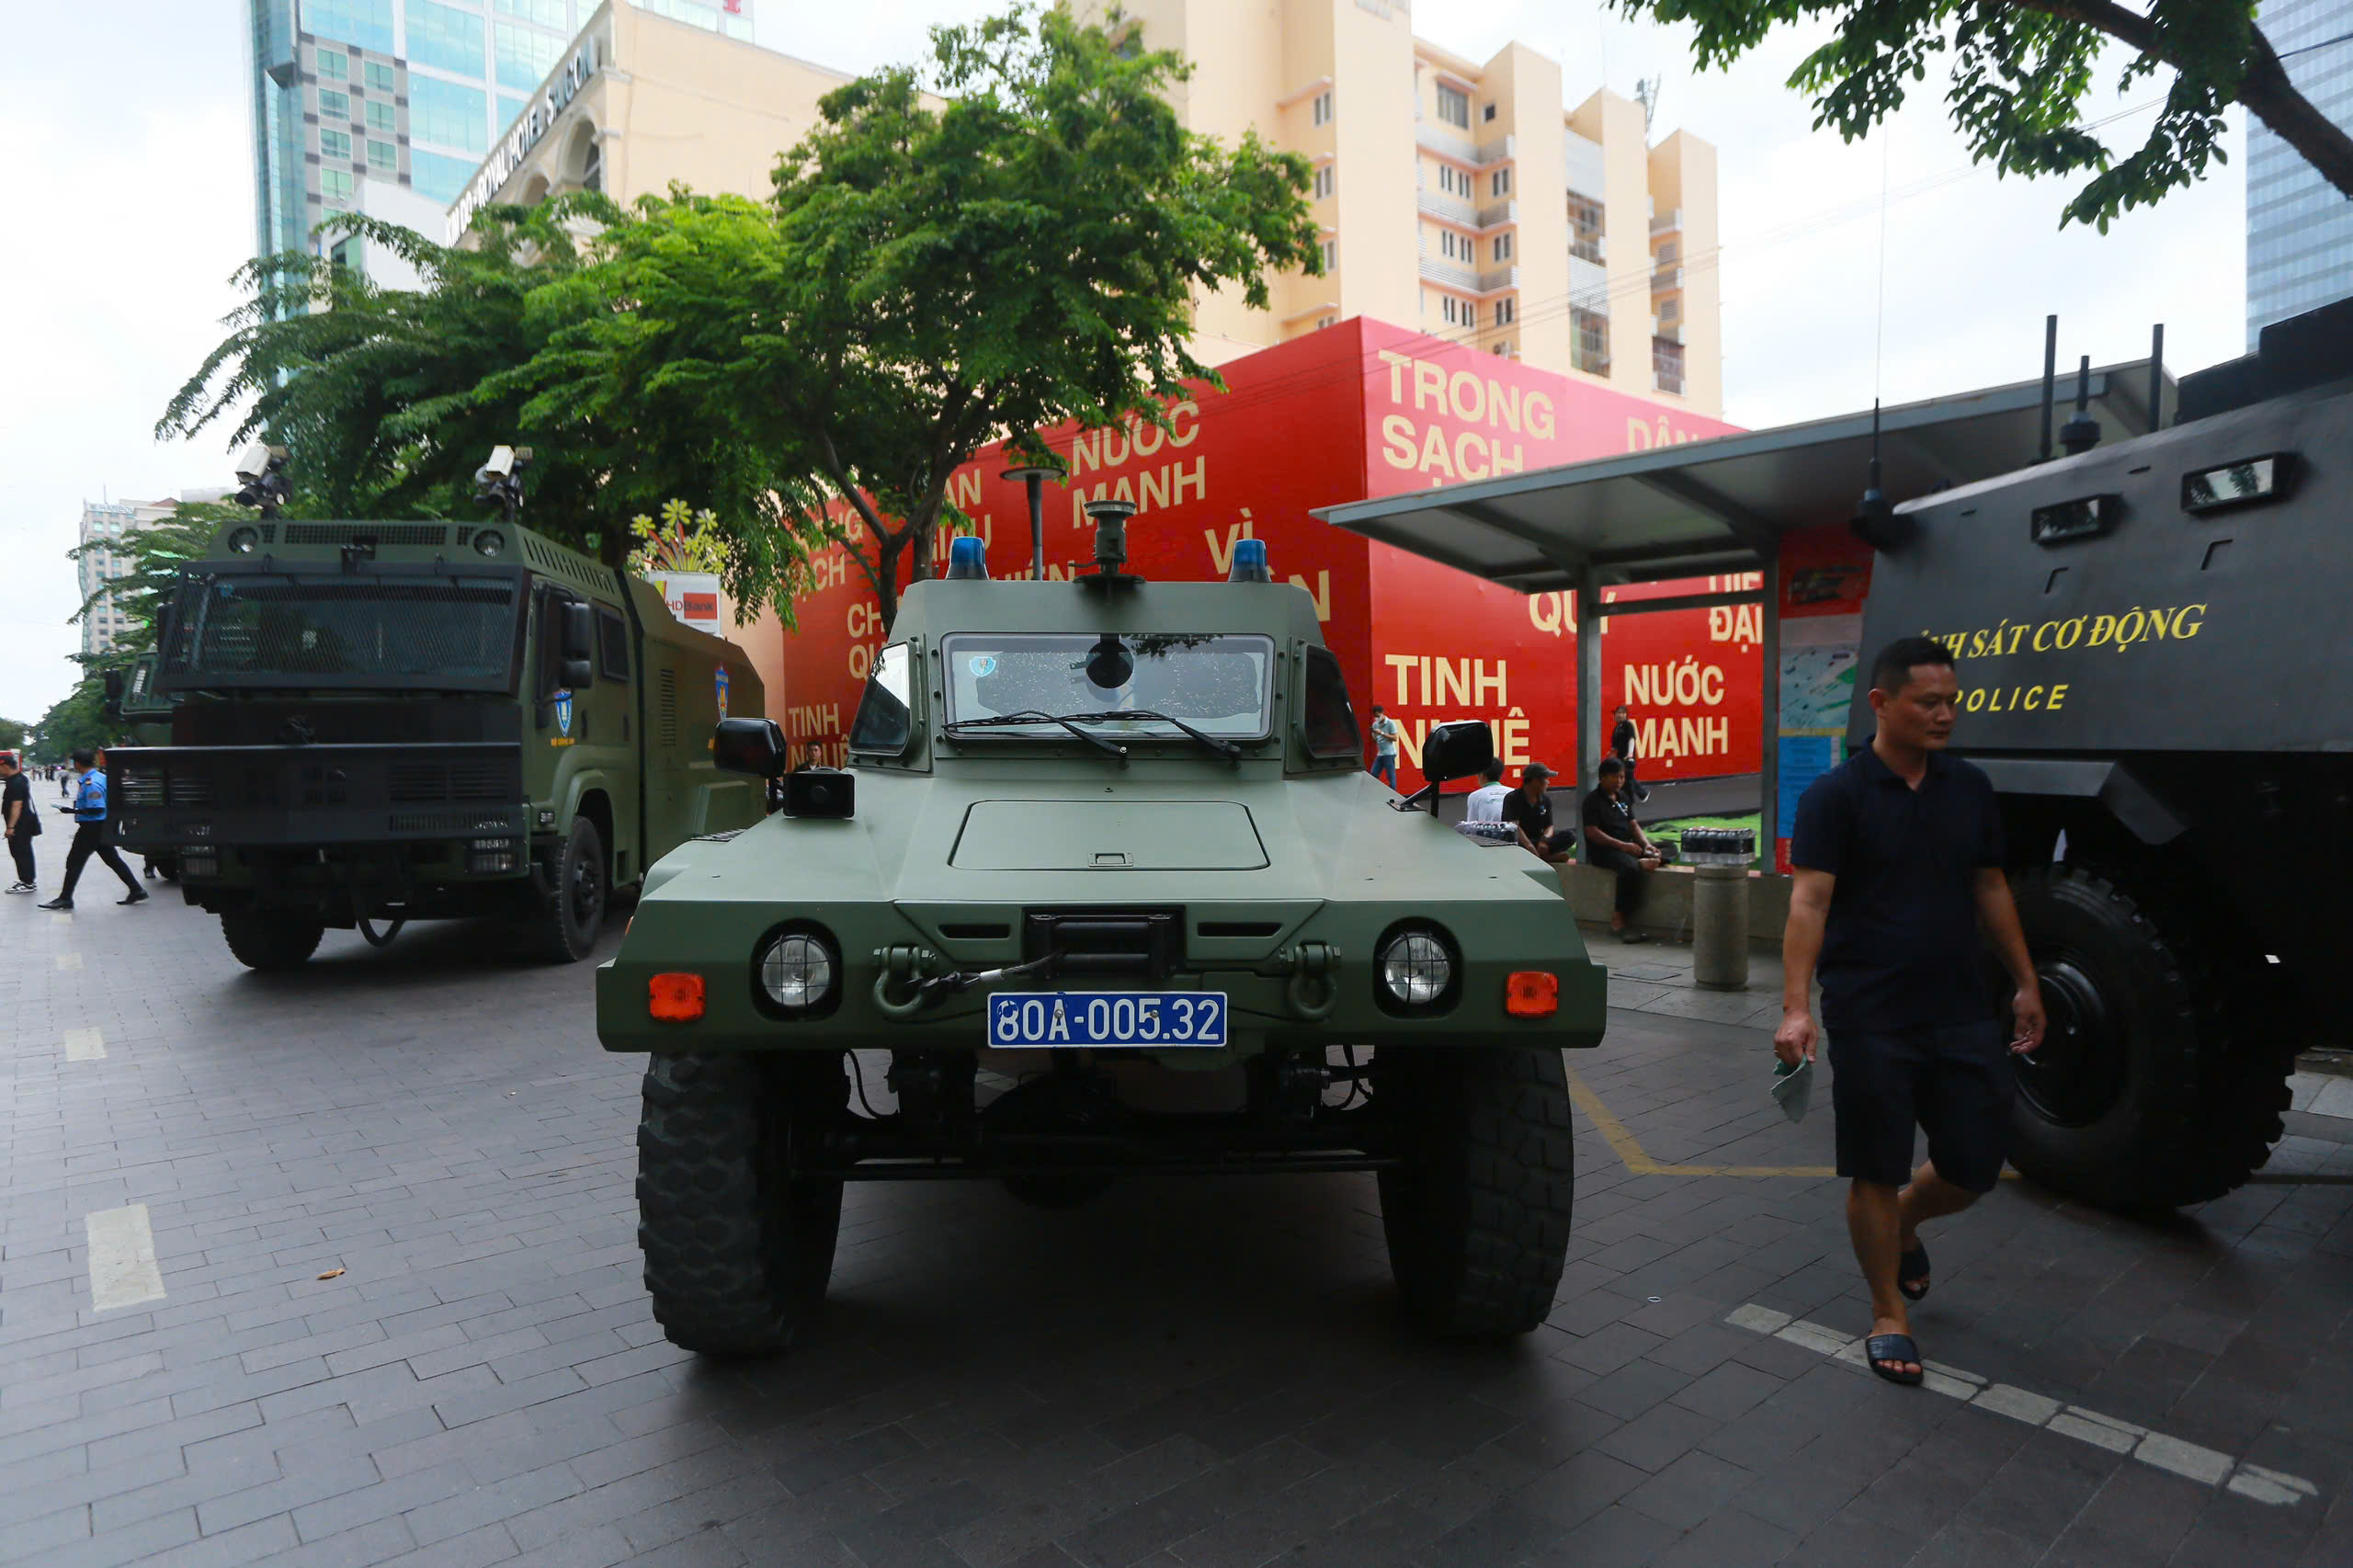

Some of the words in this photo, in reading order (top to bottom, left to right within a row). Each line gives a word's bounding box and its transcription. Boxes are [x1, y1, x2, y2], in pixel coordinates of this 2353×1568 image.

[508, 104, 542, 173] HOTEL
[545, 35, 597, 127] SAIGON
[1379, 349, 1555, 441] TRONG
[1382, 414, 1524, 488] SẠCH
[1709, 604, 1763, 653] ĐẠI
[1967, 618, 2030, 659] SÁT
[2033, 614, 2088, 653] CƠ
[2085, 604, 2208, 653] ĐỘNG
[1385, 653, 1507, 708] TINH
[1625, 653, 1725, 707] NƯỚC
[788, 702, 840, 738] TINH
[1631, 716, 1729, 768] MẠNH
[996, 998, 1221, 1042] 80A-005.32
